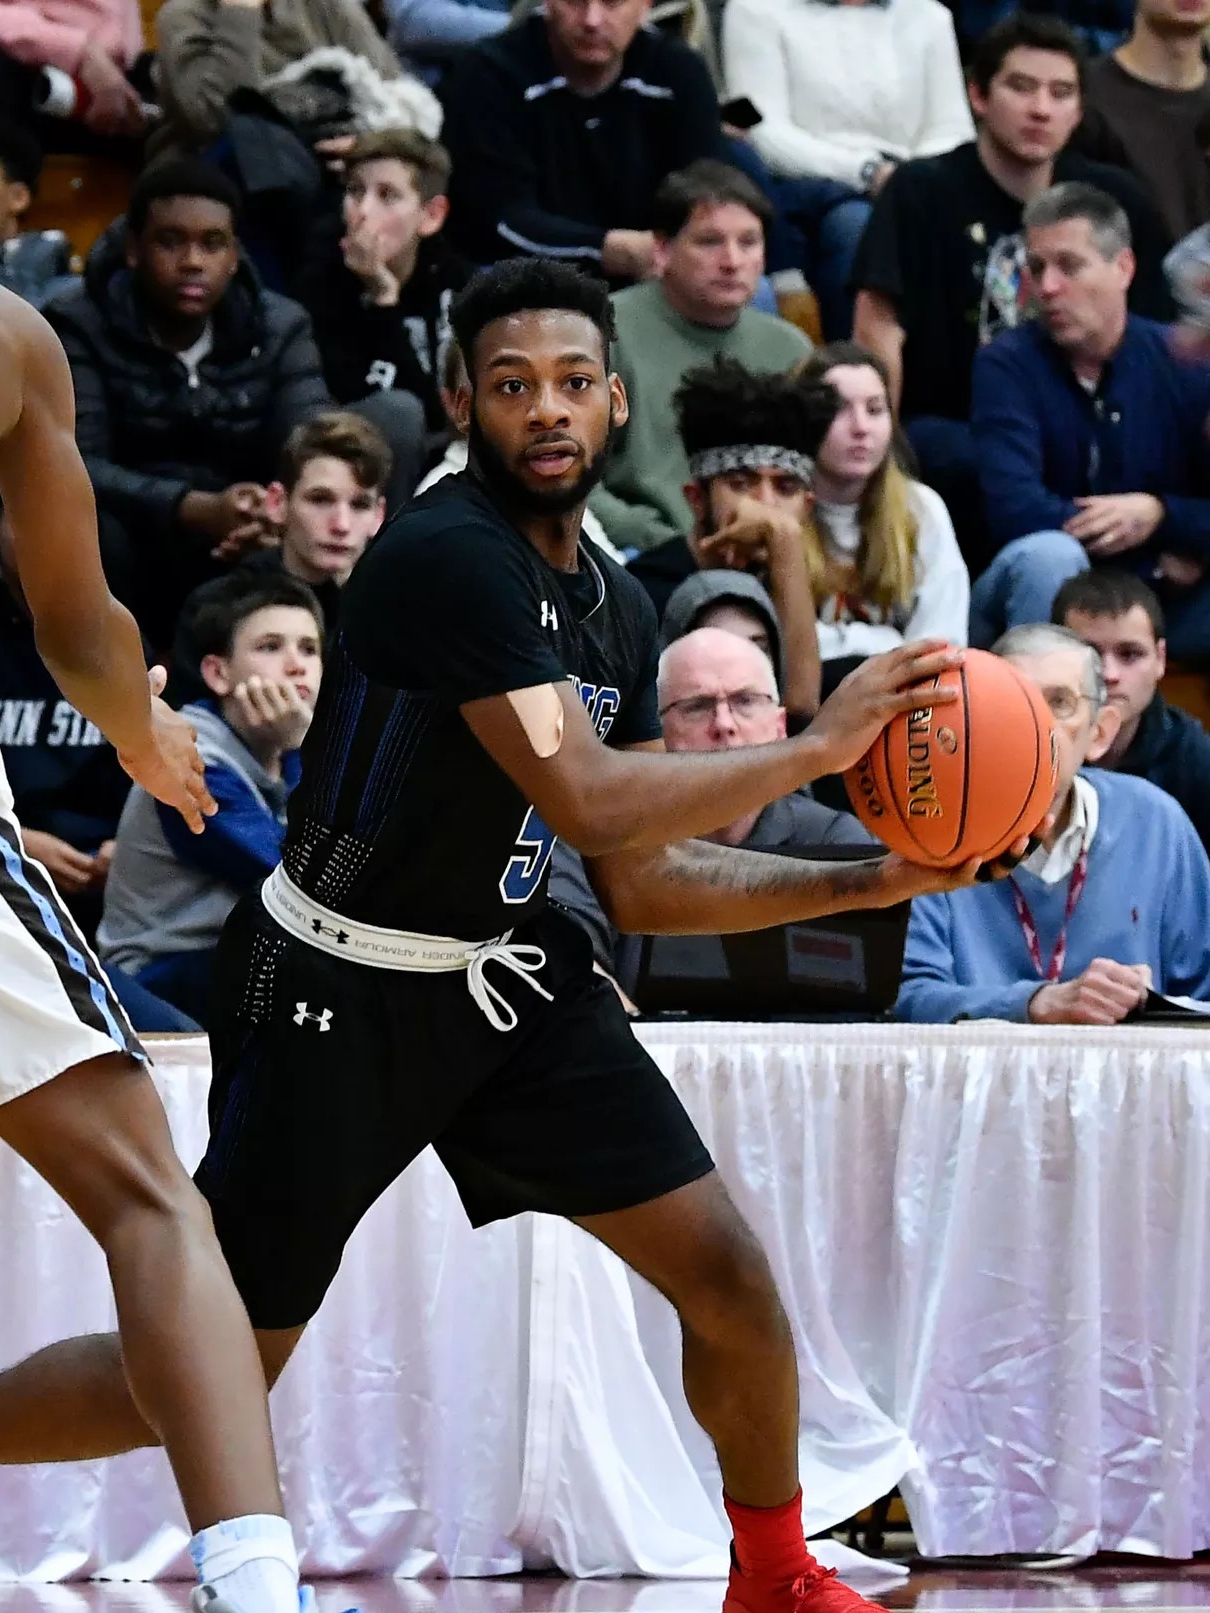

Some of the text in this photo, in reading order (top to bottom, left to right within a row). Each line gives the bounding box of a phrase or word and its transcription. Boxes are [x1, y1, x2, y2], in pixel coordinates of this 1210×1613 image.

[566, 673, 621, 742] NG
[906, 674, 943, 818] ALDING
[498, 803, 559, 904] 5
[354, 939, 418, 958] ARMOUR
